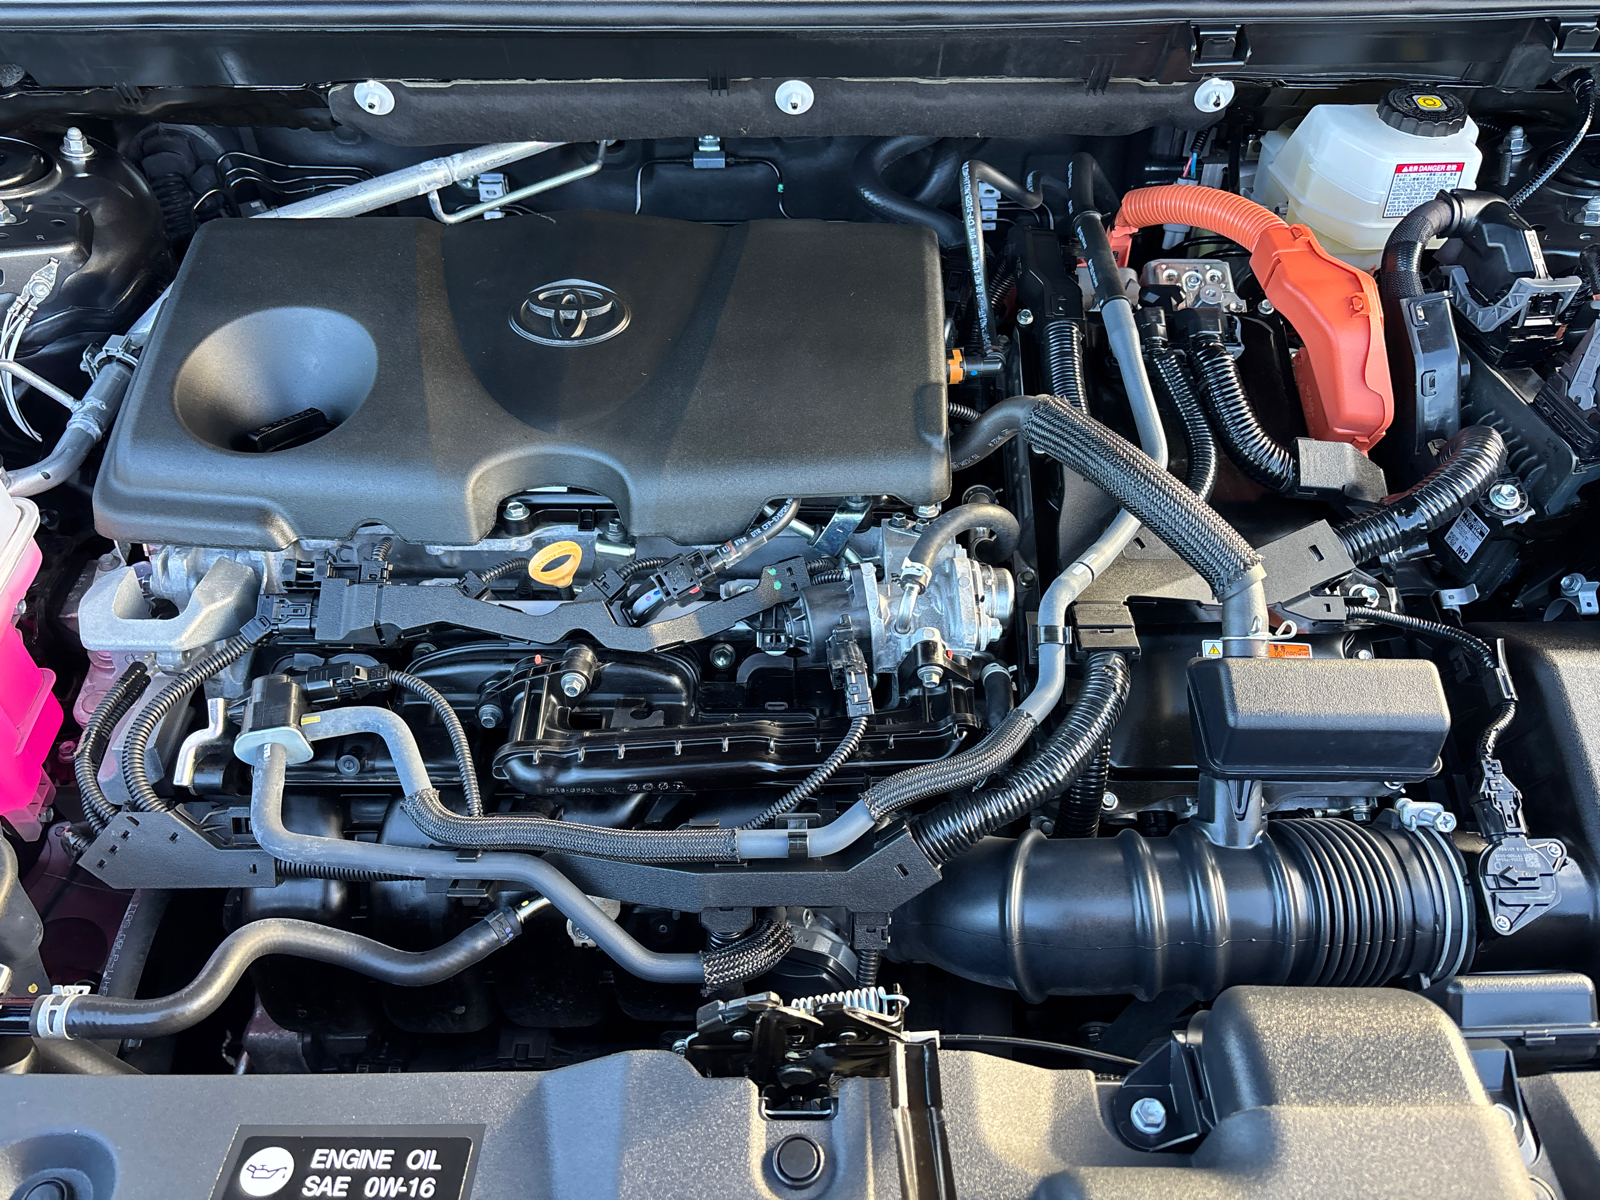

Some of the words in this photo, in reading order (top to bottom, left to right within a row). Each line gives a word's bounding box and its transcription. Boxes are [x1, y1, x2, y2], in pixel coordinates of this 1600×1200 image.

[1456, 545, 1469, 560] M9
[310, 1149, 395, 1170] ENGINE
[406, 1149, 442, 1170] OIL
[301, 1175, 352, 1197] SAE
[364, 1177, 436, 1198] 0W-16
